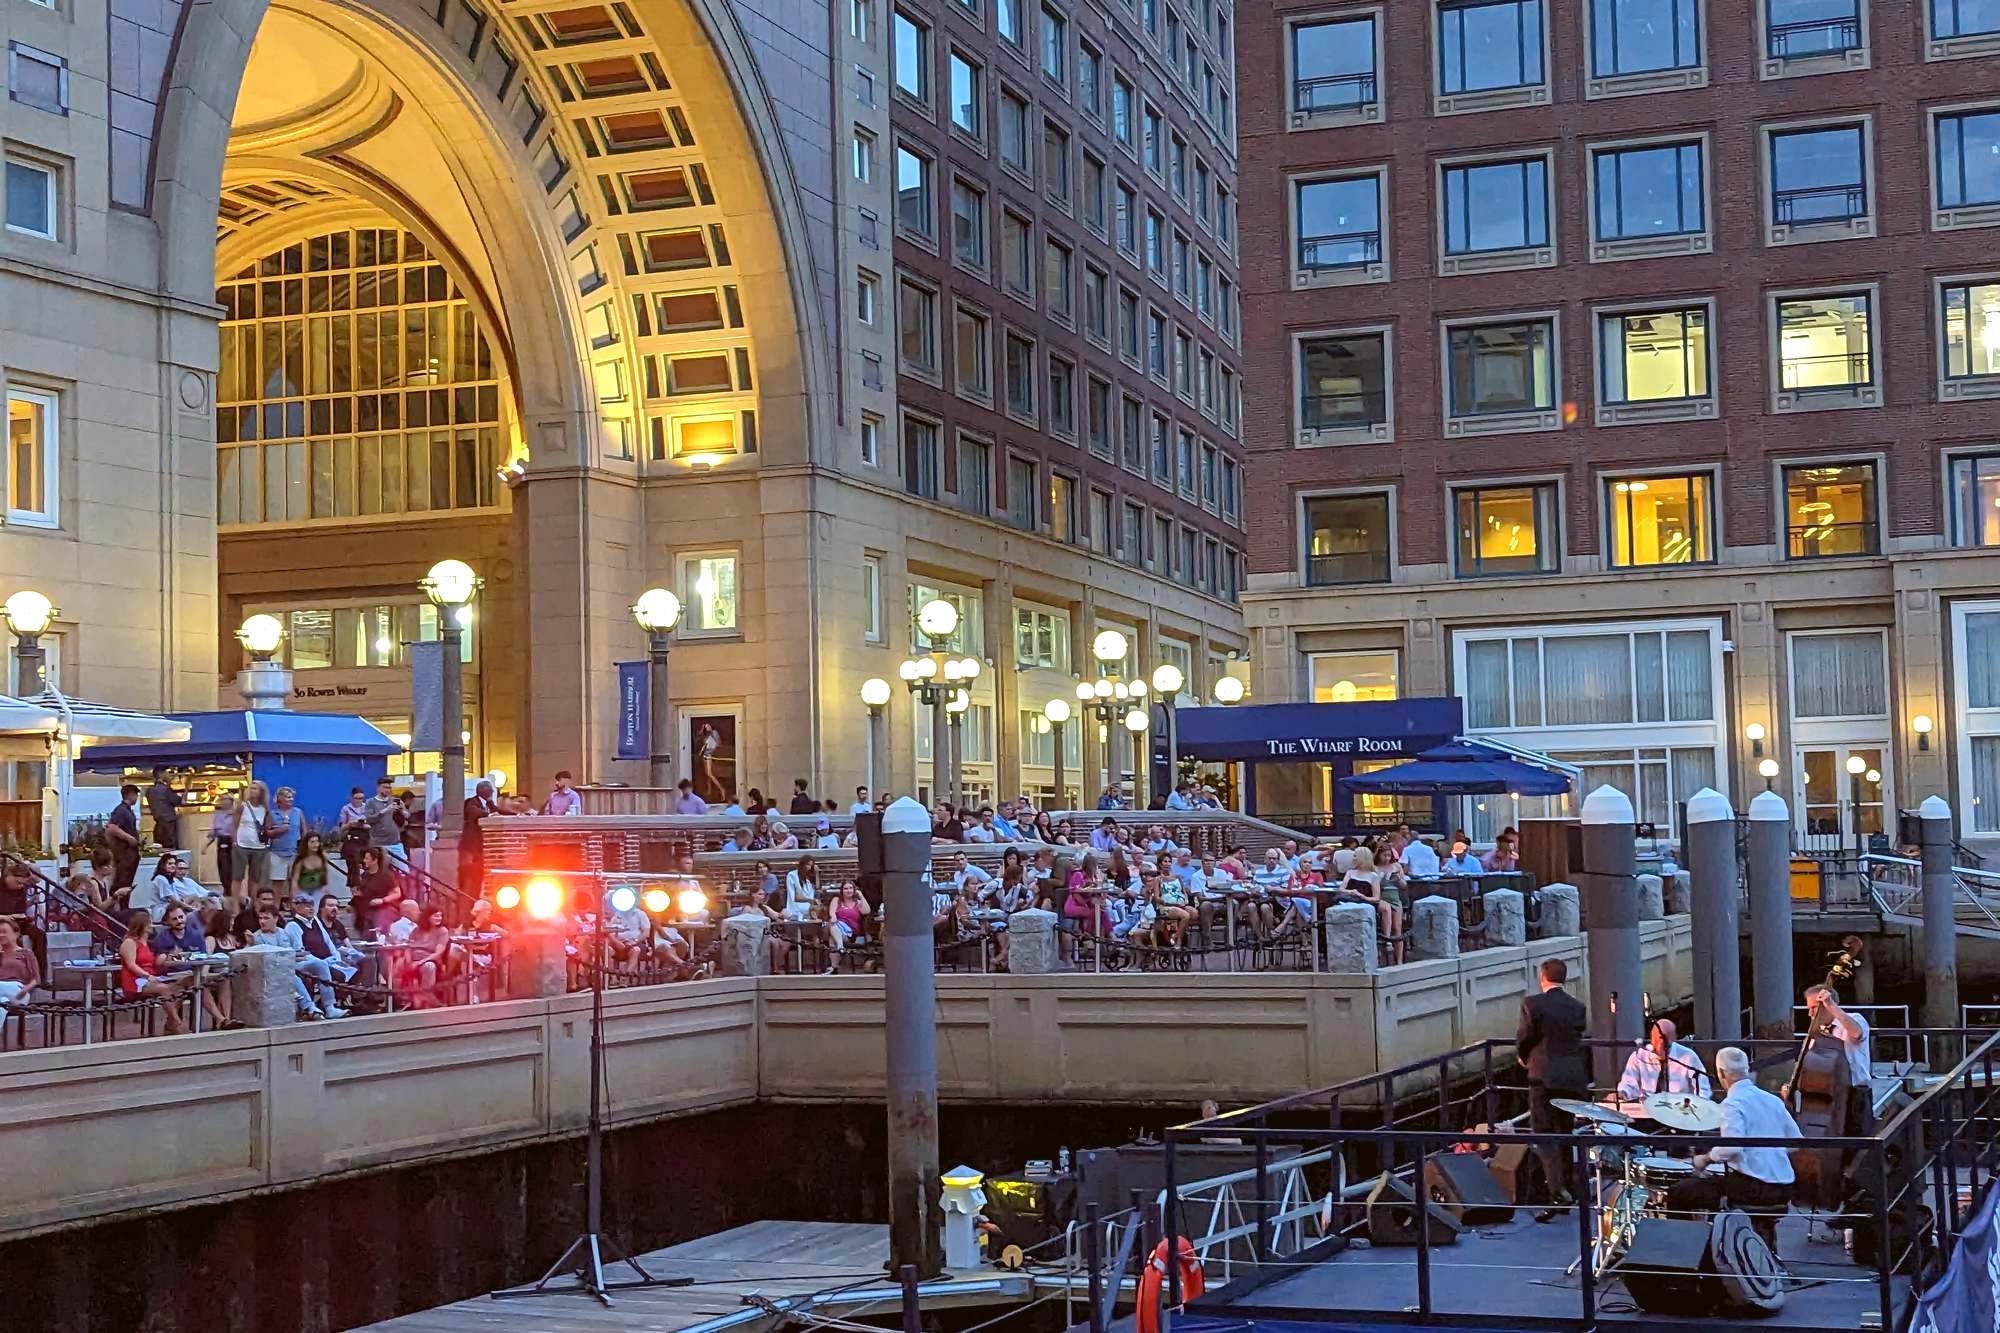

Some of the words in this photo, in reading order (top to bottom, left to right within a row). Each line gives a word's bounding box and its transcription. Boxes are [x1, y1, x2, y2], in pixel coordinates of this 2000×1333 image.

[1266, 739, 1297, 755] THE
[1299, 738, 1354, 753] WHARF
[1357, 737, 1403, 752] ROOM
